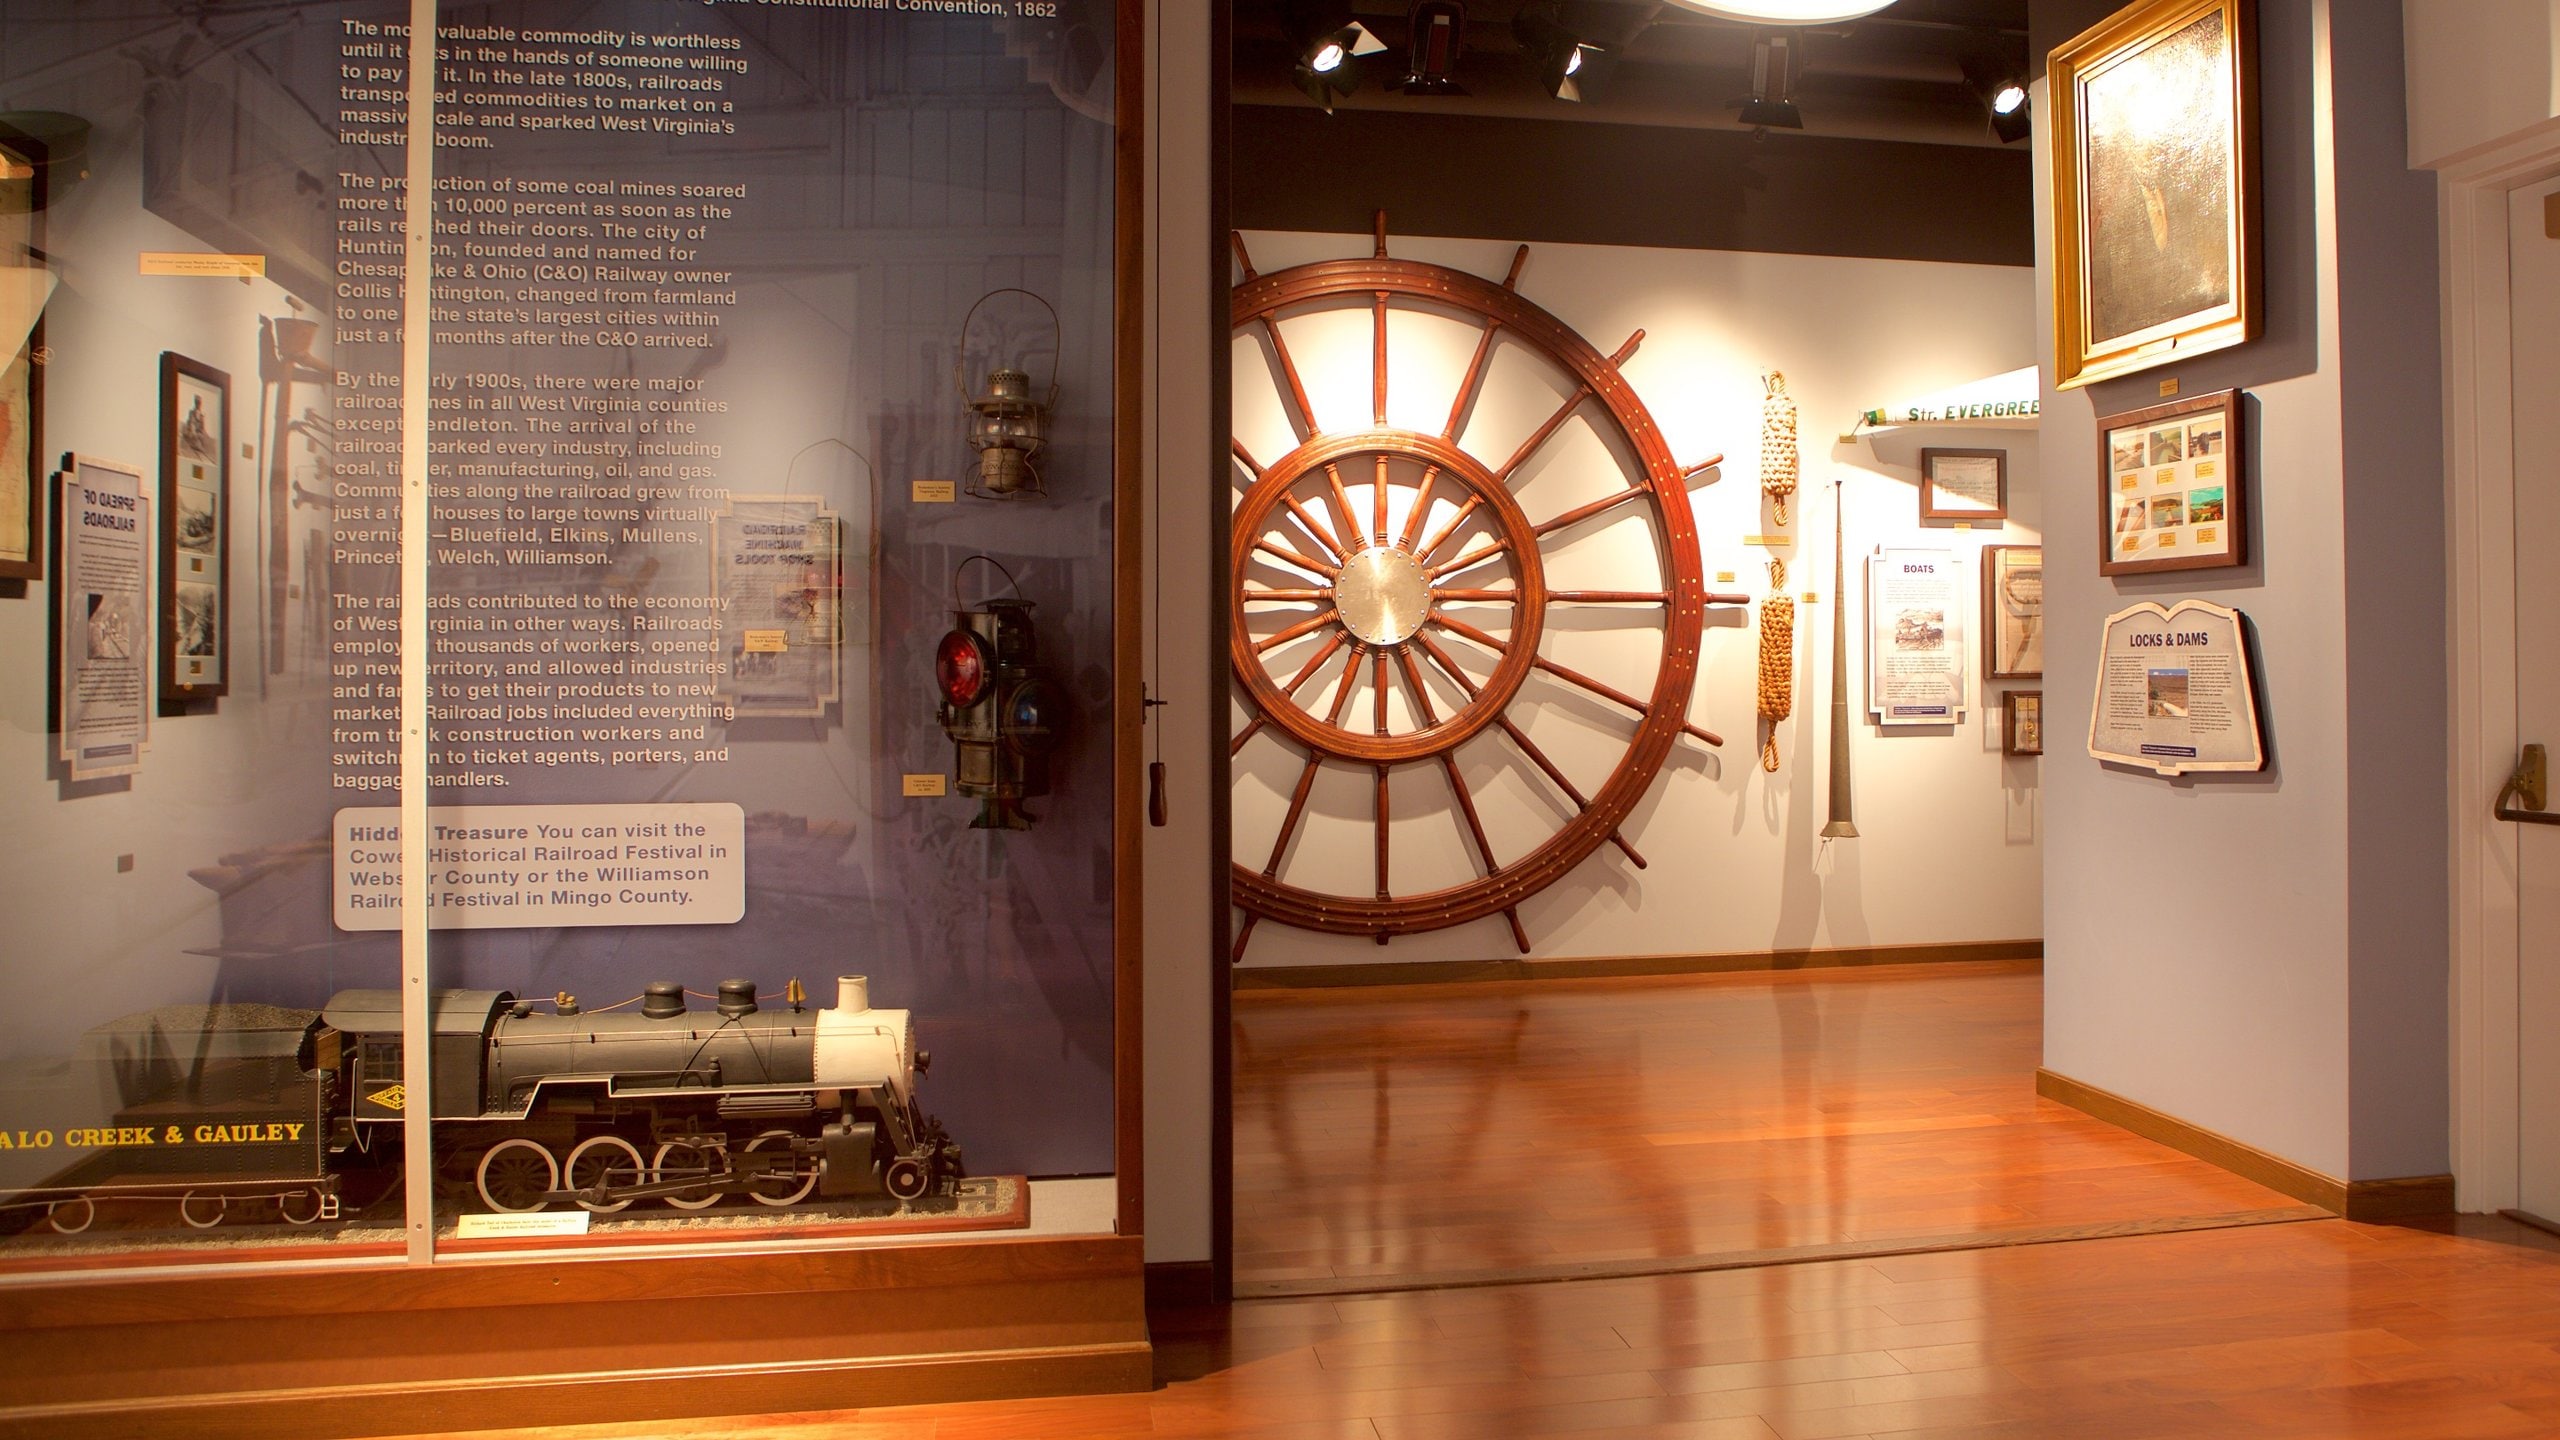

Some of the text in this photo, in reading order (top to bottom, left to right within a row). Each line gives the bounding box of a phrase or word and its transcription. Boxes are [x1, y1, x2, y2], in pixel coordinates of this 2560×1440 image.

[896, 0, 1057, 17] Convention, 1862
[342, 21, 741, 50] The valuable commodity is worthless
[342, 44, 747, 75] until it in the hands of someone willing
[340, 66, 722, 92] to pay it. In the late 1800s, railroads
[463, 92, 733, 113] commodities to market on a
[340, 109, 734, 137] massiv cale and sparked West Virginia's
[435, 132, 494, 148] boom.
[338, 174, 746, 198] The prouction of some coal mines soared
[337, 198, 732, 219] more 10,000 percent as soon as the
[337, 239, 696, 261] Huntinon, founded and named for
[337, 261, 732, 285] Chesapke & Ohio (C&O) Railway owner
[336, 307, 719, 328] to one the state's largest cities within
[336, 372, 704, 394] By the 1900s, there were major
[468, 395, 484, 410] in
[490, 395, 513, 410] all
[519, 395, 566, 411] West
[571, 396, 642, 415] Virginia
[648, 397, 728, 412] counties
[1908, 407, 1937, 421] Str.
[334, 460, 716, 482] coal, manufacturing, oil, and gas.
[334, 482, 730, 503] Commuties along the railroad grew from
[550, 527, 704, 546] Elkins, Mullens,
[438, 549, 613, 568] Welch, Williamson.
[1904, 565, 1934, 573] BOATS
[333, 594, 730, 613] The contributed to the economy
[333, 615, 723, 635] of West in other ways. Railroads
[2130, 632, 2208, 647] LOCKS & DAMS
[506, 705, 548, 724] jobs
[553, 704, 633, 720] included
[638, 704, 735, 723] everything
[333, 725, 705, 743] from construction workers and
[434, 823, 706, 841] Treasure You can visit the
[428, 844, 727, 863] Historical Railroad Festival in
[350, 866, 710, 888] Websr County or the Williamson
[350, 889, 693, 909] Railrd Festival in Mingo County.
[65, 1128, 155, 1146] CREEK
[164, 1126, 184, 1144] &
[195, 1124, 304, 1142] GAULEY
